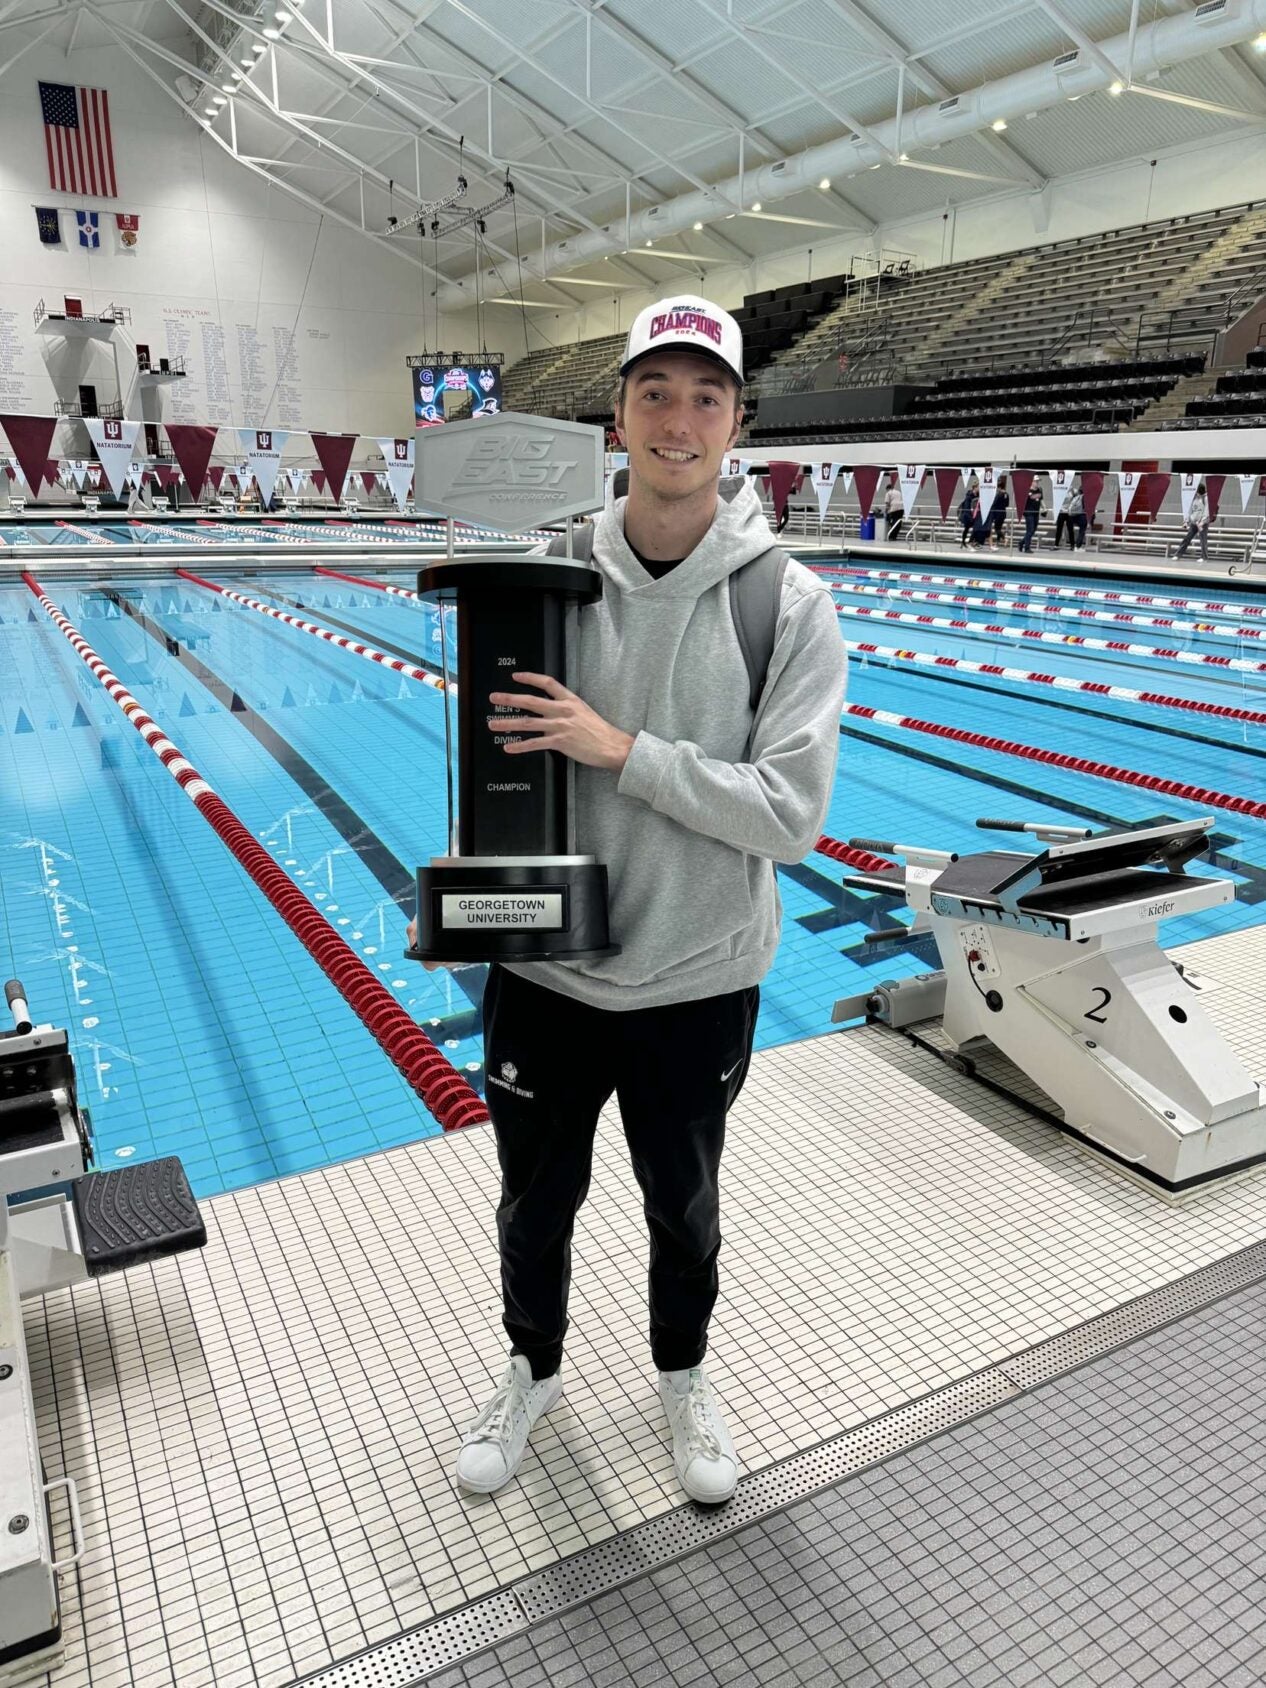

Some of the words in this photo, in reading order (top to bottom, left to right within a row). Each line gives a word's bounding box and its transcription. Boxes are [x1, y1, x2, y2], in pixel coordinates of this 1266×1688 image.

[649, 312, 722, 345] CHAMPIONS
[96, 442, 132, 450] NATATORIUM
[466, 435, 556, 461] BIG
[249, 452, 280, 460] NATATORIUM
[452, 460, 579, 486] EAST
[488, 492, 568, 503] CONFERENCE
[497, 657, 517, 667] 2024
[494, 736, 522, 745] DIVING
[487, 782, 531, 792] CHAMPION
[458, 899, 546, 911] GEORGETOWN
[466, 912, 538, 924] UNIVERSITY
[1083, 986, 1112, 1024] 2
